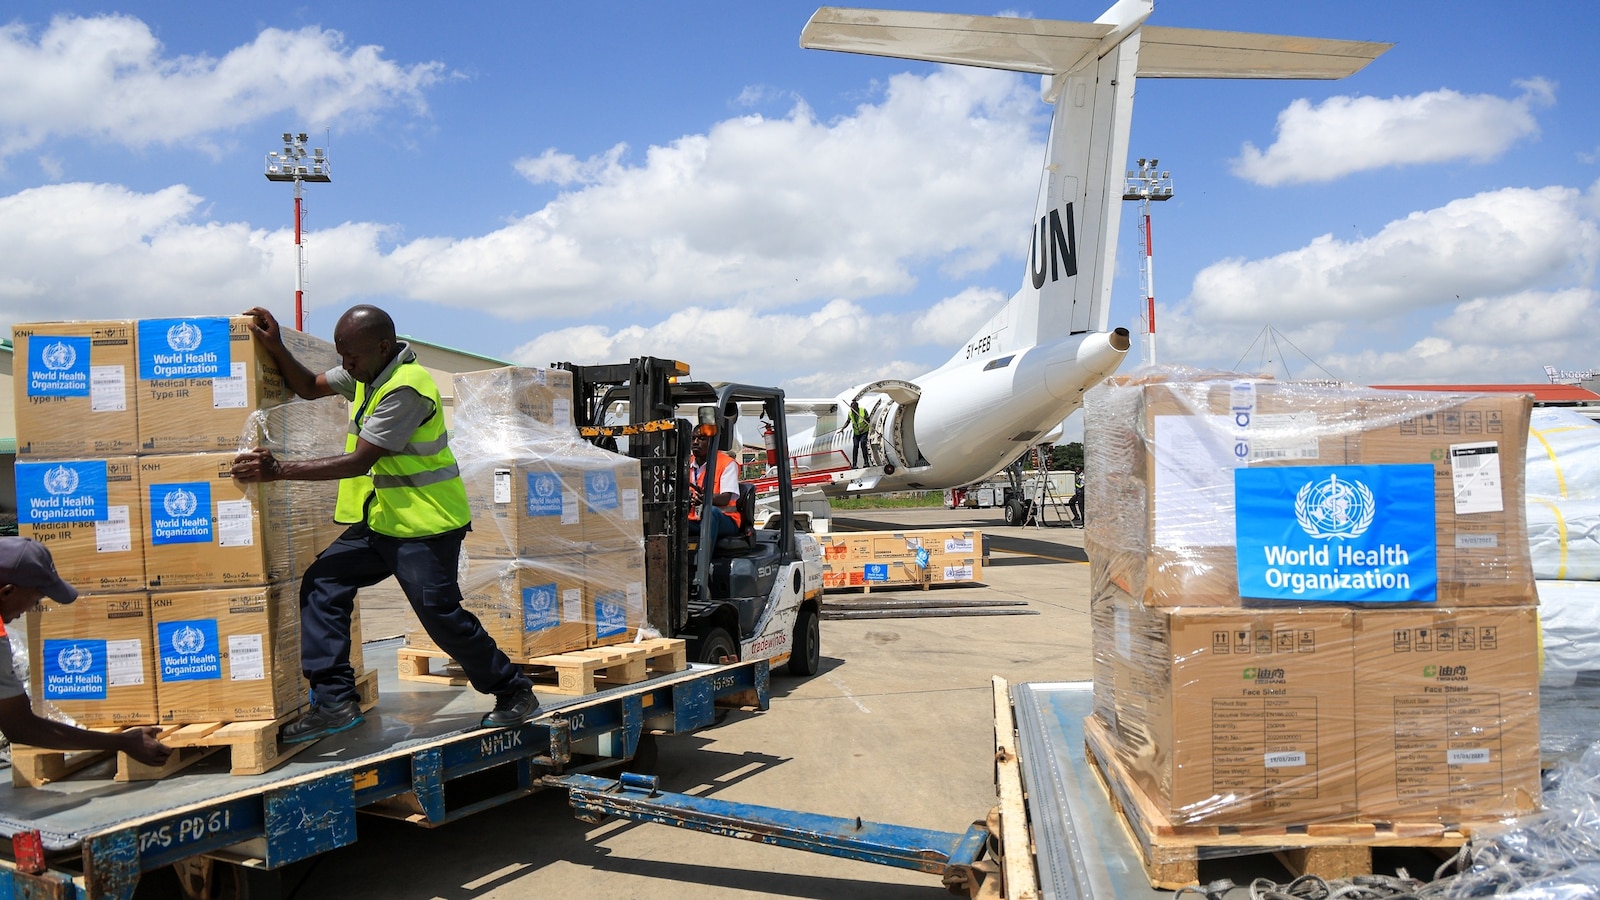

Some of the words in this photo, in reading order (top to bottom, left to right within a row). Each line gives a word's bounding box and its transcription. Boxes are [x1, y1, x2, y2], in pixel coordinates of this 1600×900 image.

[1032, 202, 1077, 290] UN
[966, 336, 991, 359] 5Y-FEB
[154, 353, 182, 364] World
[186, 352, 217, 362] Health
[32, 371, 56, 380] World
[59, 370, 86, 380] Health
[154, 364, 217, 376] Organization
[32, 380, 86, 390] Organization
[151, 379, 186, 388] Medical
[190, 378, 213, 386] Face
[29, 396, 51, 404] Type
[151, 391, 173, 400] Type
[30, 498, 59, 507] World
[63, 496, 94, 506] Health
[530, 504, 560, 512] Organization
[31, 508, 94, 520] Organization
[33, 522, 69, 530] Medical
[155, 519, 179, 528] World
[182, 517, 208, 526] Health
[33, 533, 55, 542] Type
[156, 527, 208, 538] Organization
[1264, 546, 1328, 566] World
[1338, 544, 1409, 566] Health
[1265, 568, 1410, 593] Organization
[752, 633, 786, 655] tradewinds
[164, 657, 188, 666] World
[190, 654, 216, 664] Health
[165, 665, 216, 676] Organization
[48, 675, 72, 684] World
[76, 675, 102, 683] Health
[48, 684, 102, 694] Organization
[140, 825, 172, 853] TAS
